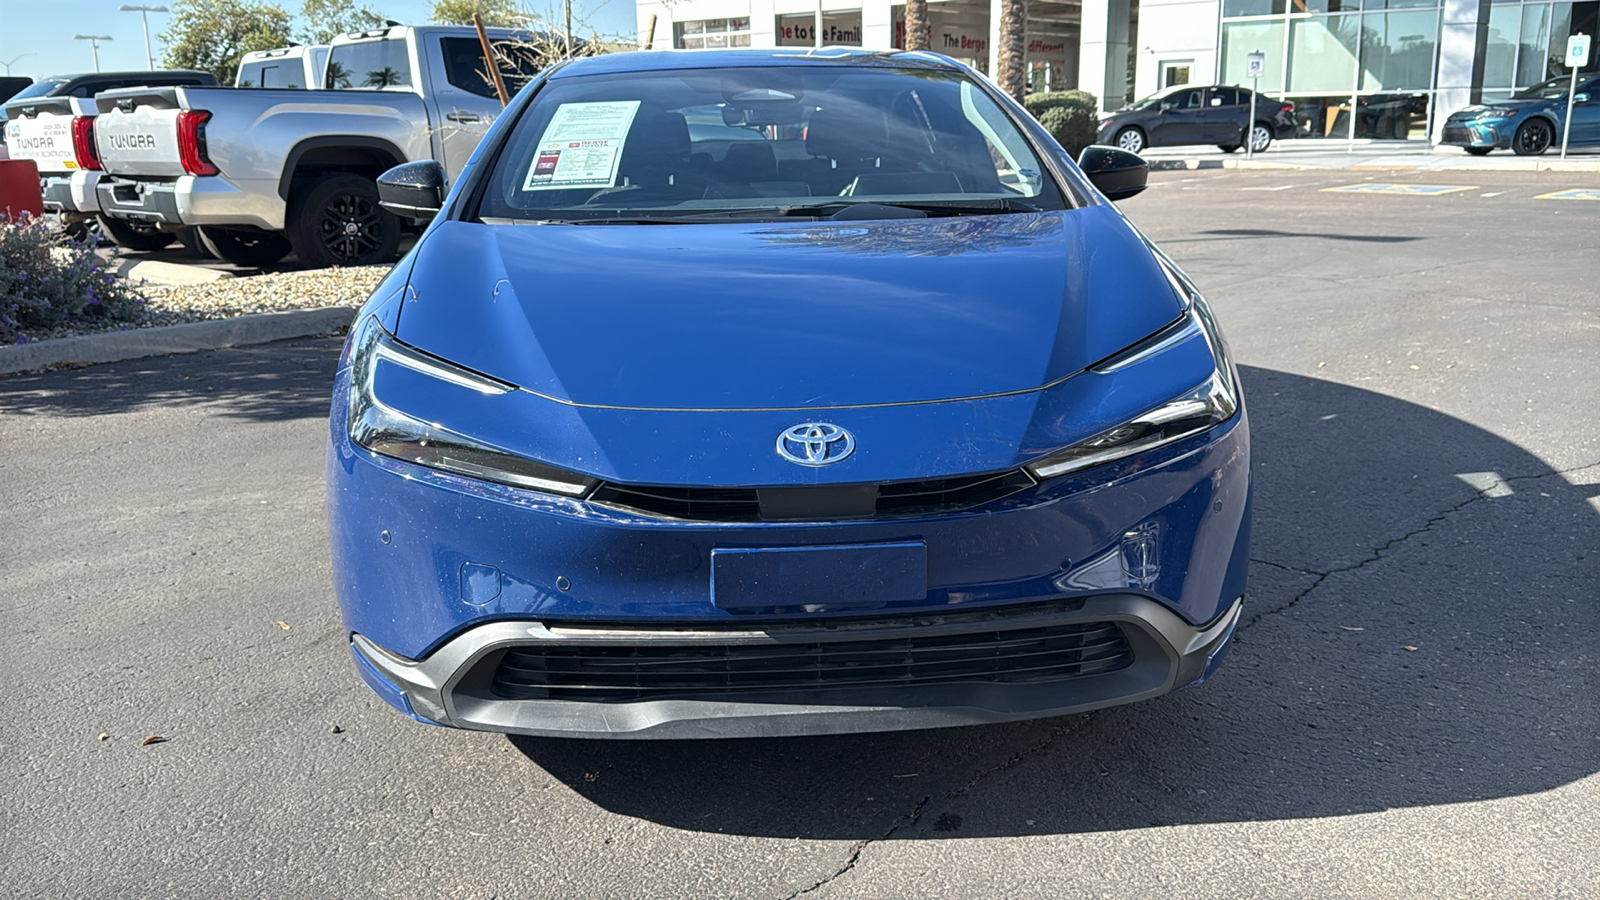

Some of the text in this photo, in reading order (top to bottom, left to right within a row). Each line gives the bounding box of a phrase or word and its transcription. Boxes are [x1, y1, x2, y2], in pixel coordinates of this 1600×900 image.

[794, 24, 807, 39] to
[810, 25, 828, 40] te
[830, 25, 861, 42] Famil
[943, 33, 959, 47] The
[961, 36, 986, 53] Berge
[1027, 39, 1064, 54] different!
[16, 137, 54, 149] TUNDRA
[109, 134, 156, 151] TUNDRA
